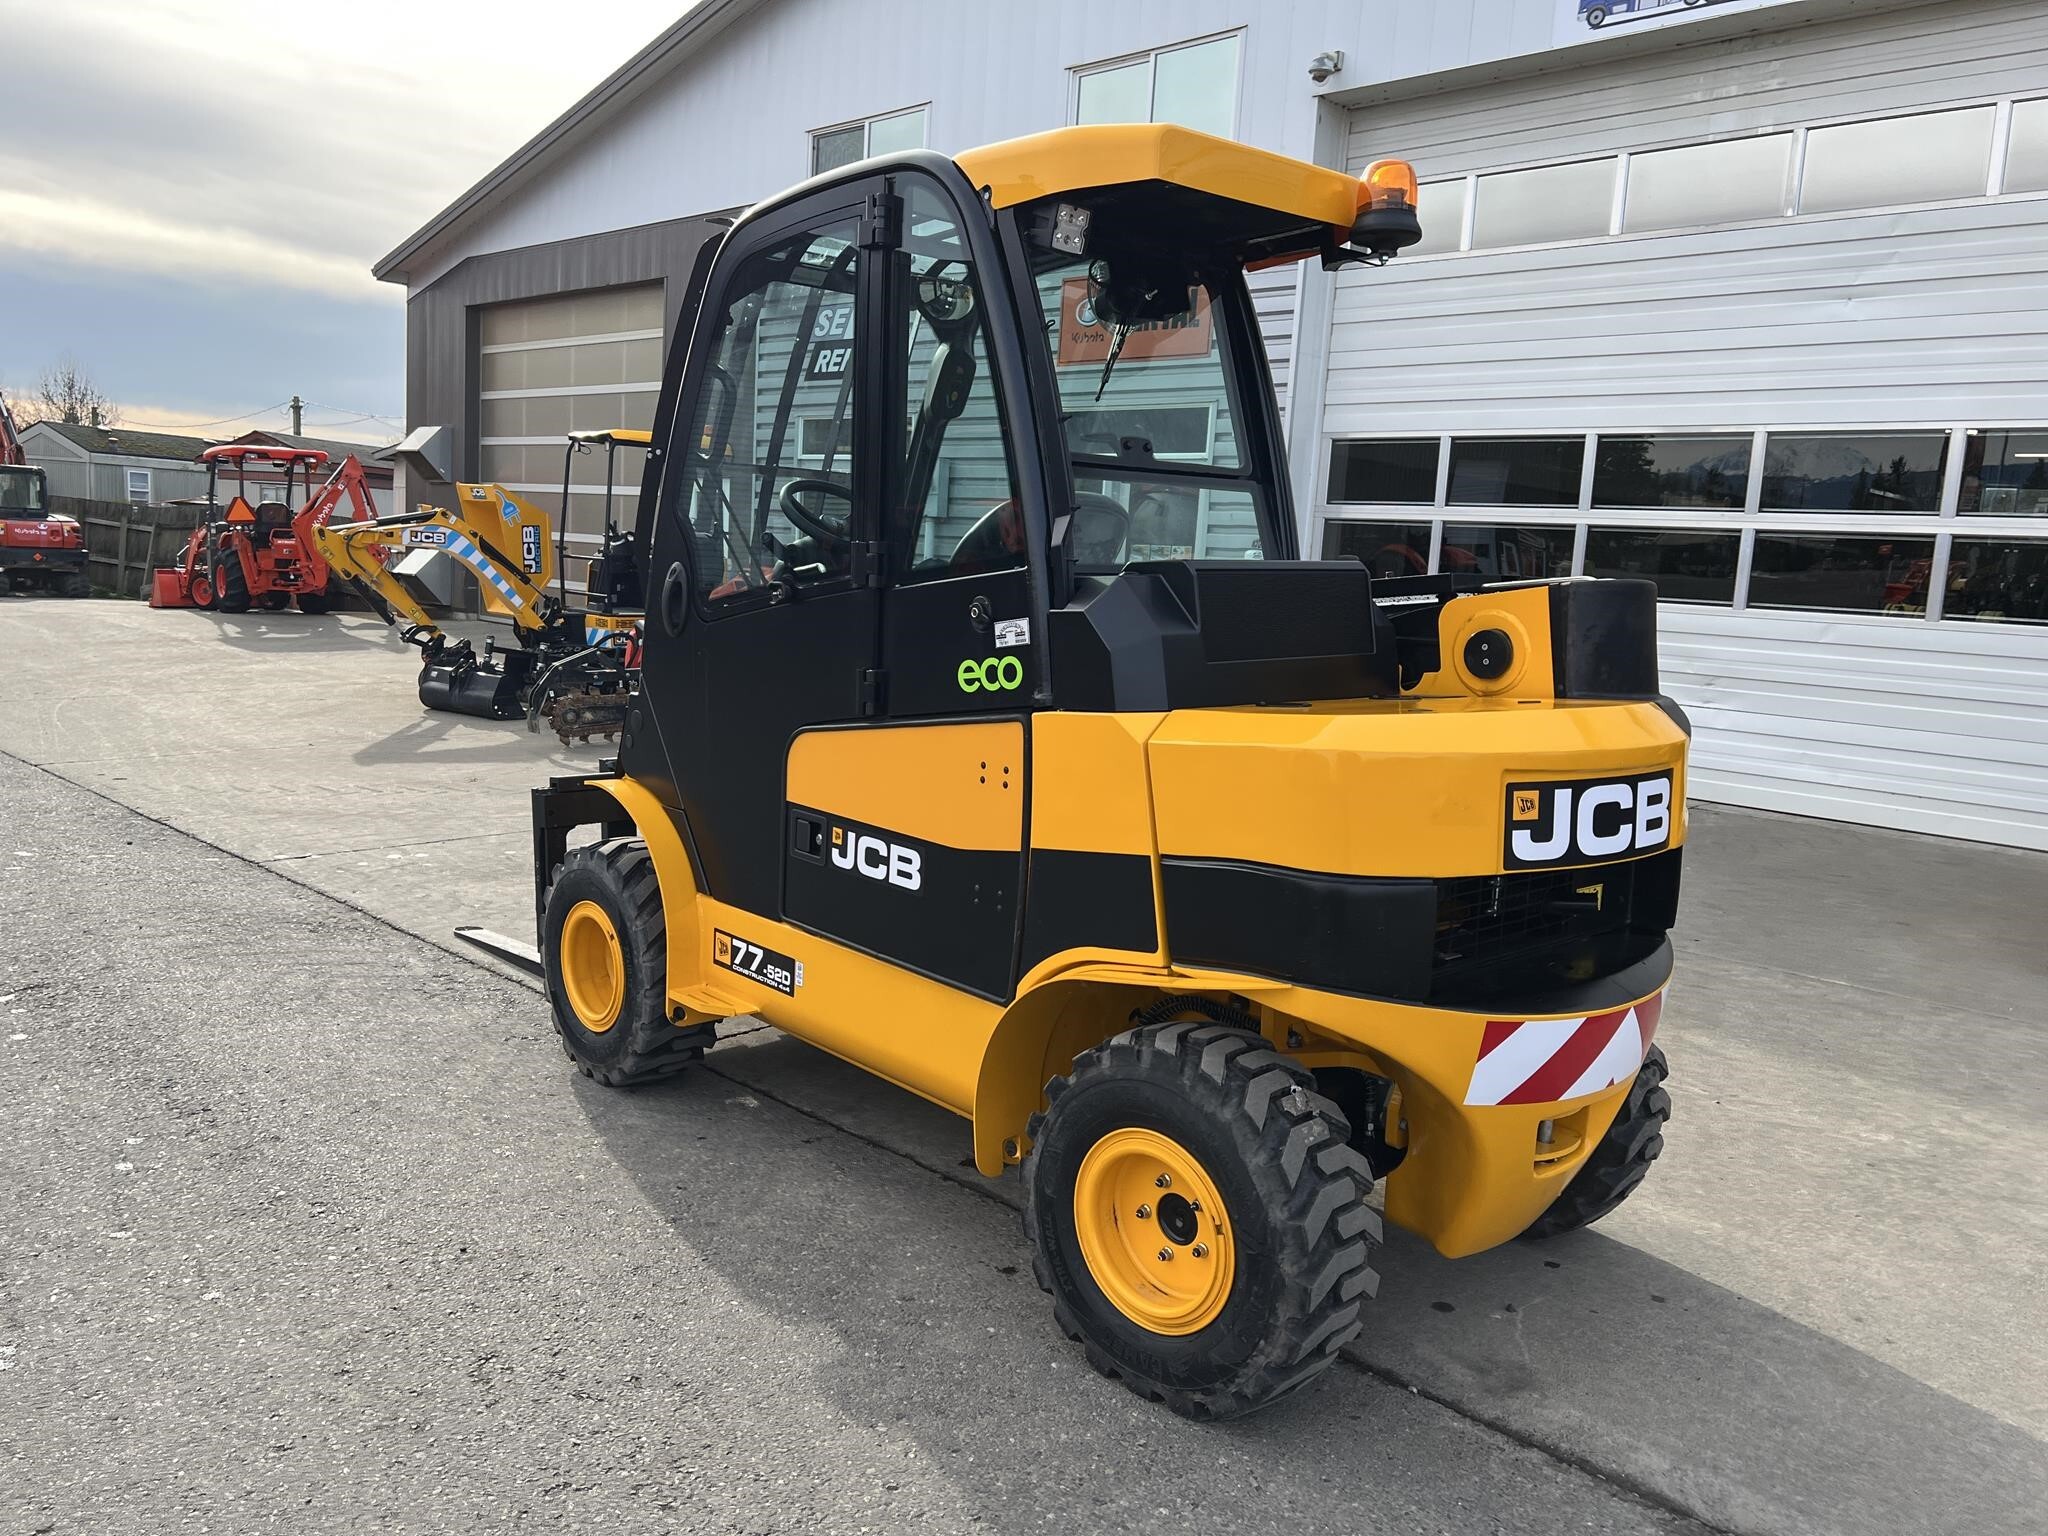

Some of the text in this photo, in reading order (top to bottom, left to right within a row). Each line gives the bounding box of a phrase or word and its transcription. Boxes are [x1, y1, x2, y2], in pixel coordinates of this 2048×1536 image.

[1071, 332, 1105, 344] Kubota
[14, 527, 40, 535] Kubota
[411, 531, 446, 544] JCB
[522, 526, 536, 573] JCB
[957, 655, 1023, 693] eco
[1518, 798, 1536, 813] JCB
[1511, 777, 1671, 861] JCB
[831, 830, 921, 891] JCB
[732, 964, 778, 988] CONSTRUCTION
